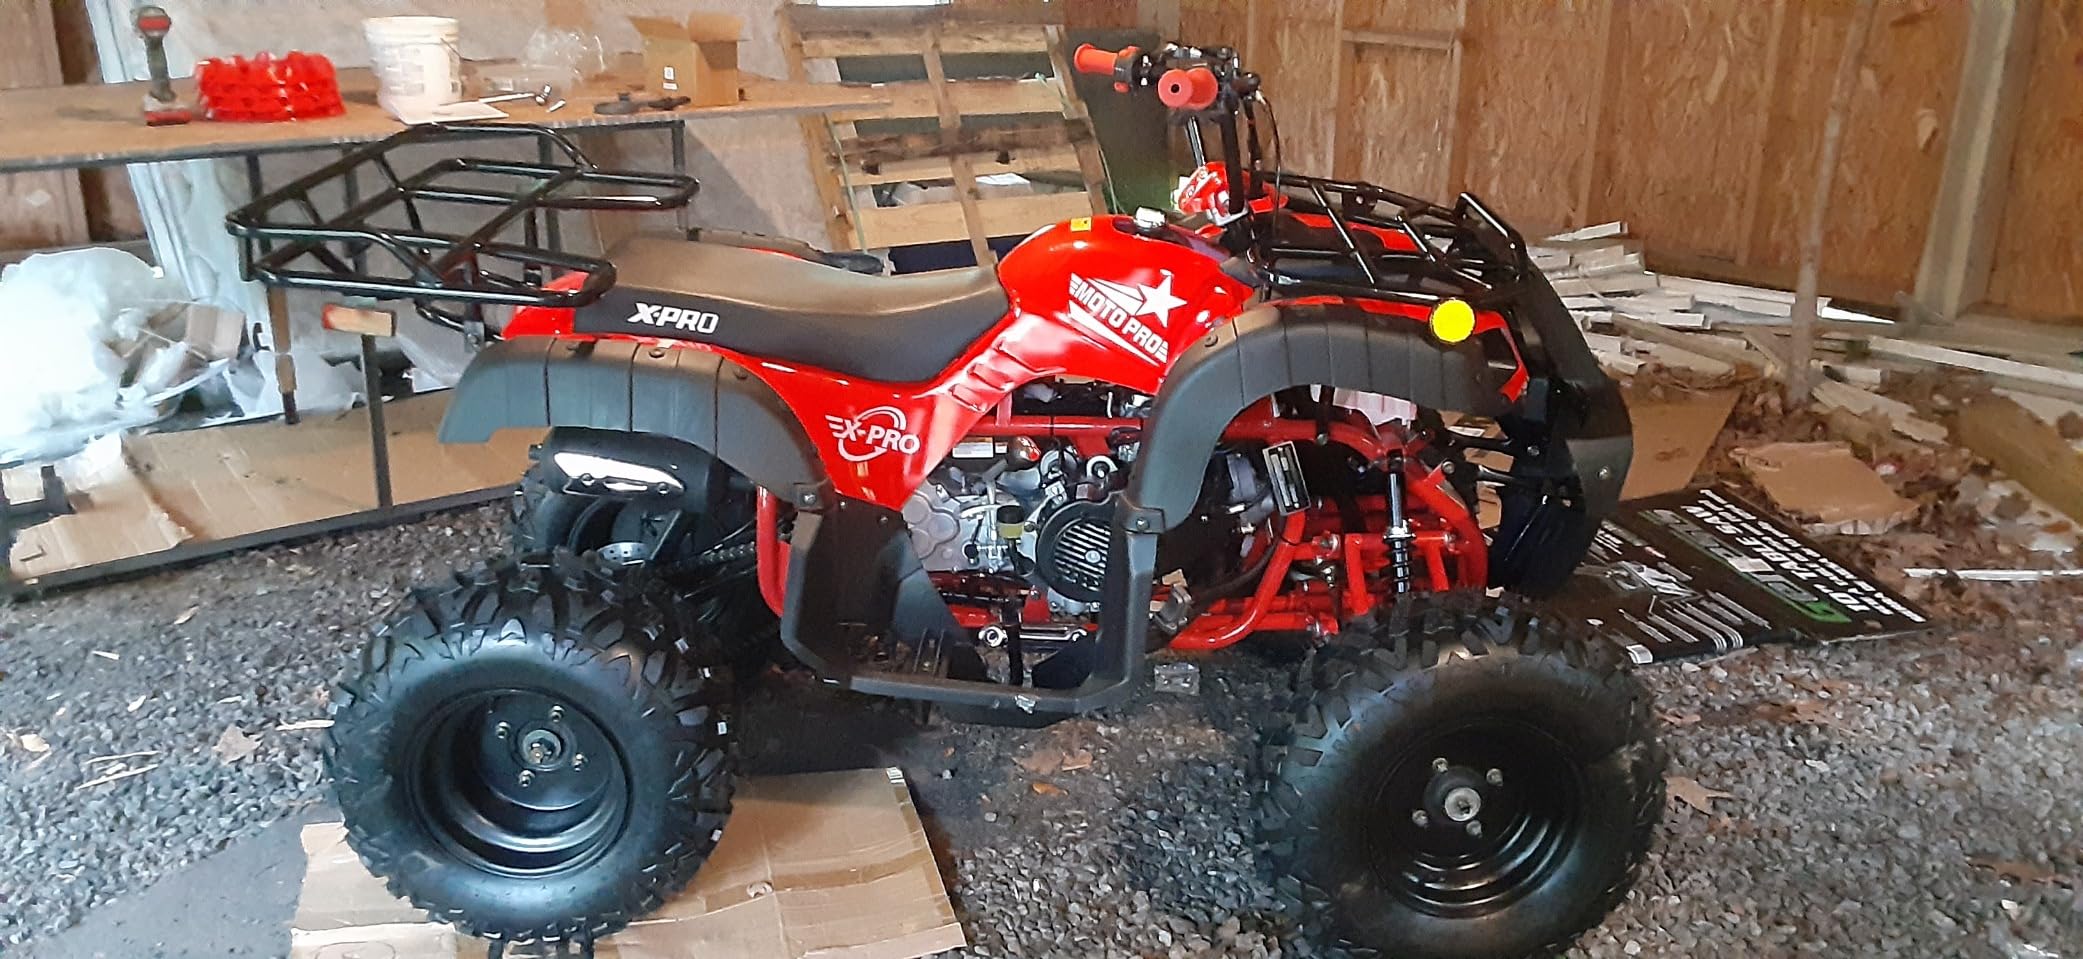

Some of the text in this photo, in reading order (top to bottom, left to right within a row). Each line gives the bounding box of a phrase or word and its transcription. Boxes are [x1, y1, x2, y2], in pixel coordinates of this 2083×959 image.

[1074, 280, 1163, 355] MOTO PRO
[830, 418, 921, 455] X-PRO
[1681, 506, 1744, 535] SAW
[1735, 536, 1819, 580] TABLE
